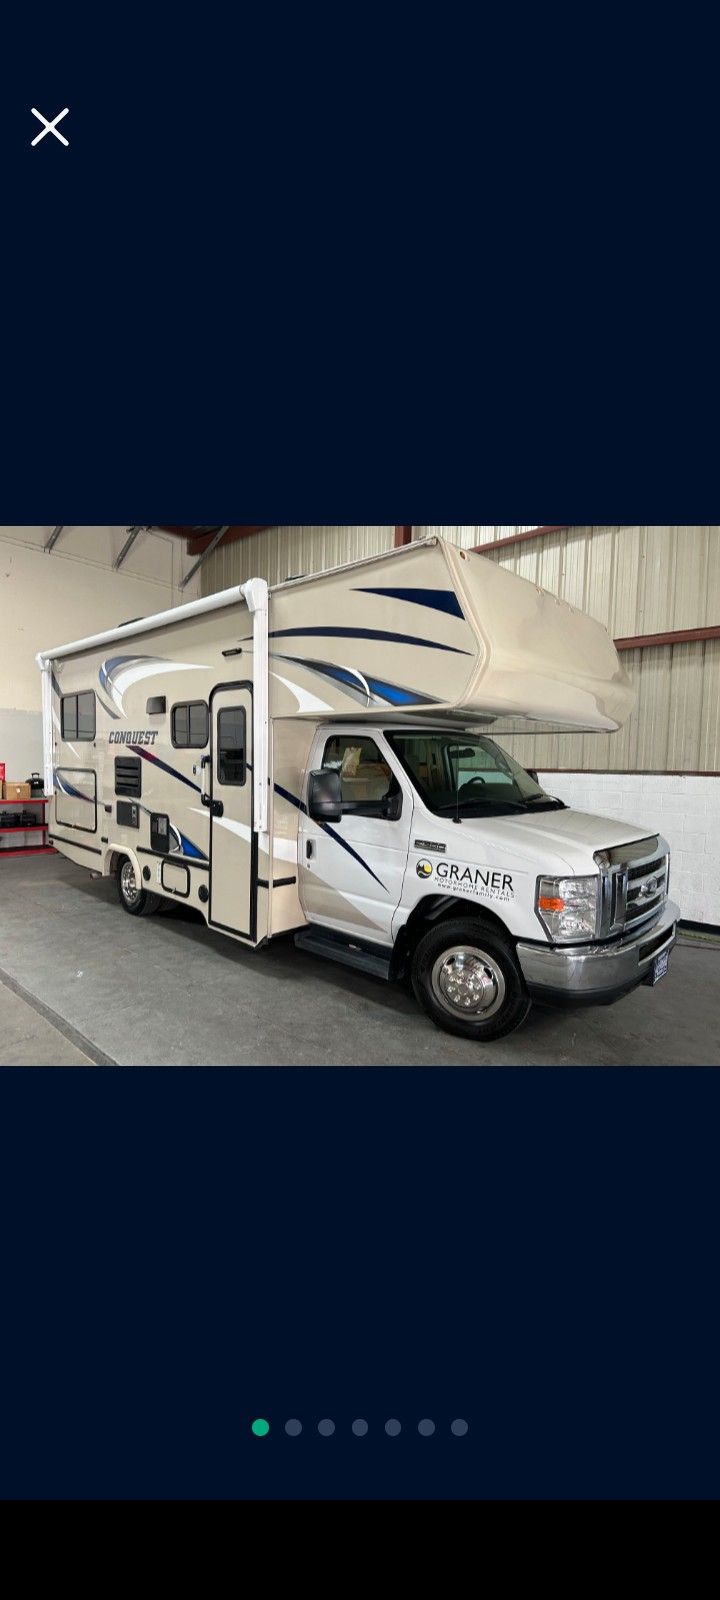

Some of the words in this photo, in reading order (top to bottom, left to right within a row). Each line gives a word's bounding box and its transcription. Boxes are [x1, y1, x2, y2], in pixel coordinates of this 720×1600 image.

[108, 730, 158, 745] CONQUEST
[434, 876, 479, 890] MOTORHOME
[480, 886, 515, 898] RENTALS
[436, 862, 514, 891] GRANER
